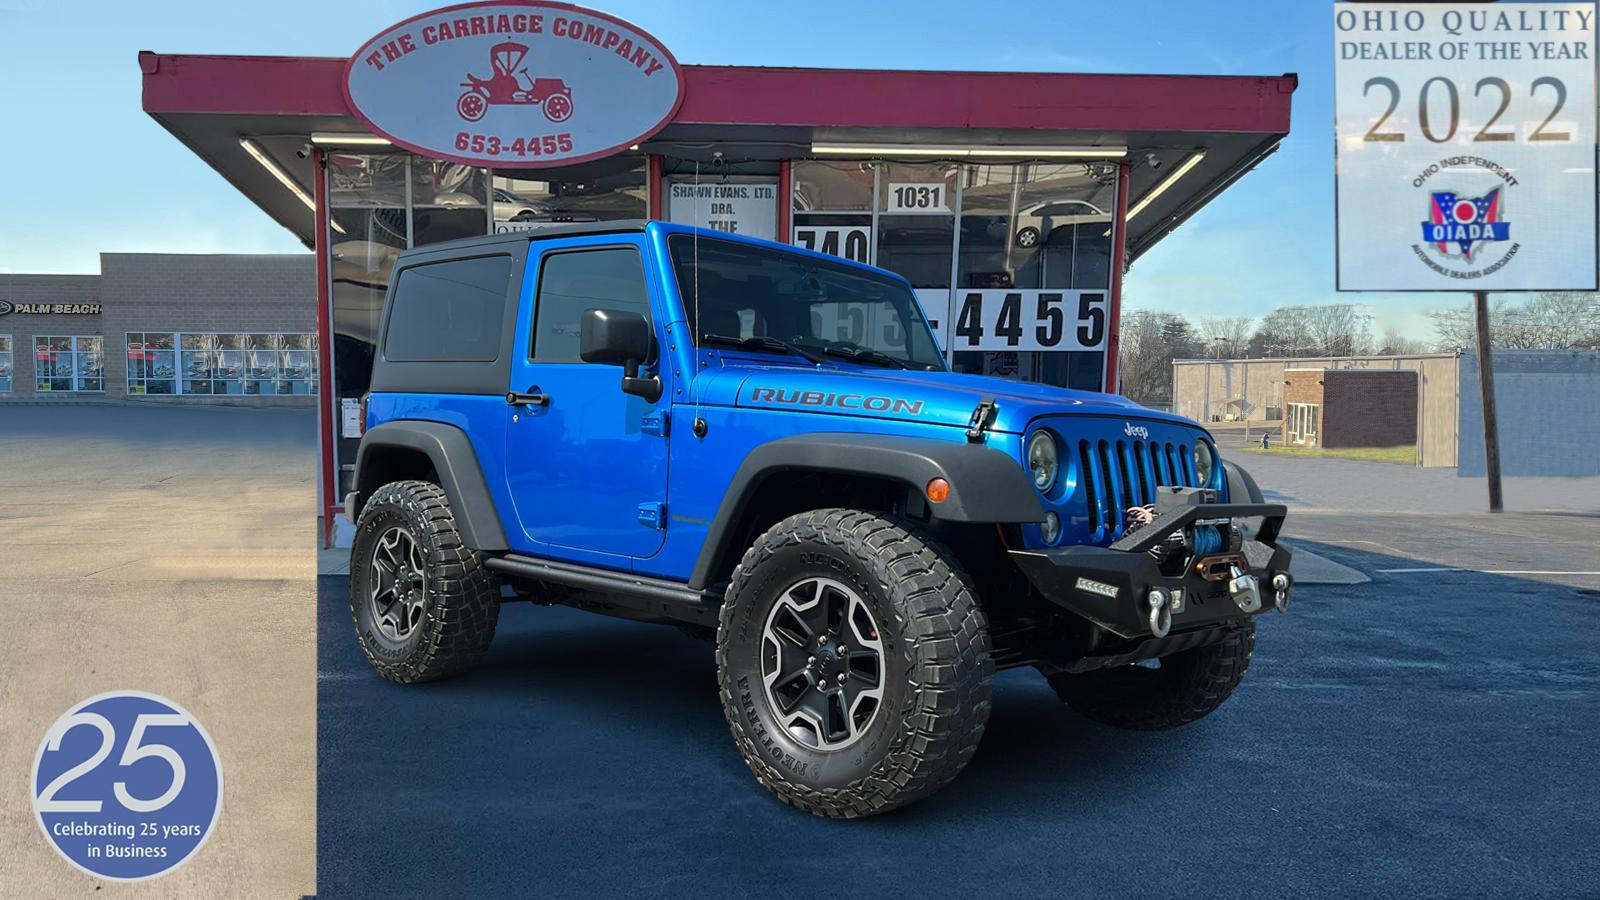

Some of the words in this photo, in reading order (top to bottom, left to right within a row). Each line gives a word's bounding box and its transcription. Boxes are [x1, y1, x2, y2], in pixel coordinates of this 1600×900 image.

[1336, 10, 1425, 31] OHIO
[1442, 10, 1593, 35] QUALITY
[365, 35, 417, 71] THE
[422, 14, 543, 45] CARRIAGE
[552, 17, 663, 76] COMPANY
[1340, 41, 1433, 60] DEALER
[1438, 41, 1470, 60] OF
[1475, 41, 1522, 60] THE
[1528, 41, 1589, 60] YEAR
[1362, 76, 1571, 143] 2022
[454, 132, 574, 156] 653-4455
[1412, 163, 1440, 188] OHIO
[1440, 155, 1519, 187] INDEPENDENT
[672, 185, 712, 198] SHAWN
[754, 187, 775, 199] LTD.
[894, 186, 940, 208] 1031
[711, 203, 736, 215] DBA.
[1432, 224, 1495, 240] OIADA
[1411, 243, 1450, 277] AUTOMOBILE
[1449, 268, 1483, 280] DEALERS
[1482, 242, 1522, 277] ASSOCIATION
[14, 304, 51, 314] PALM
[54, 304, 100, 314] BEACH
[752, 387, 924, 415] RUBICON
[1124, 421, 1149, 440] Jeep
